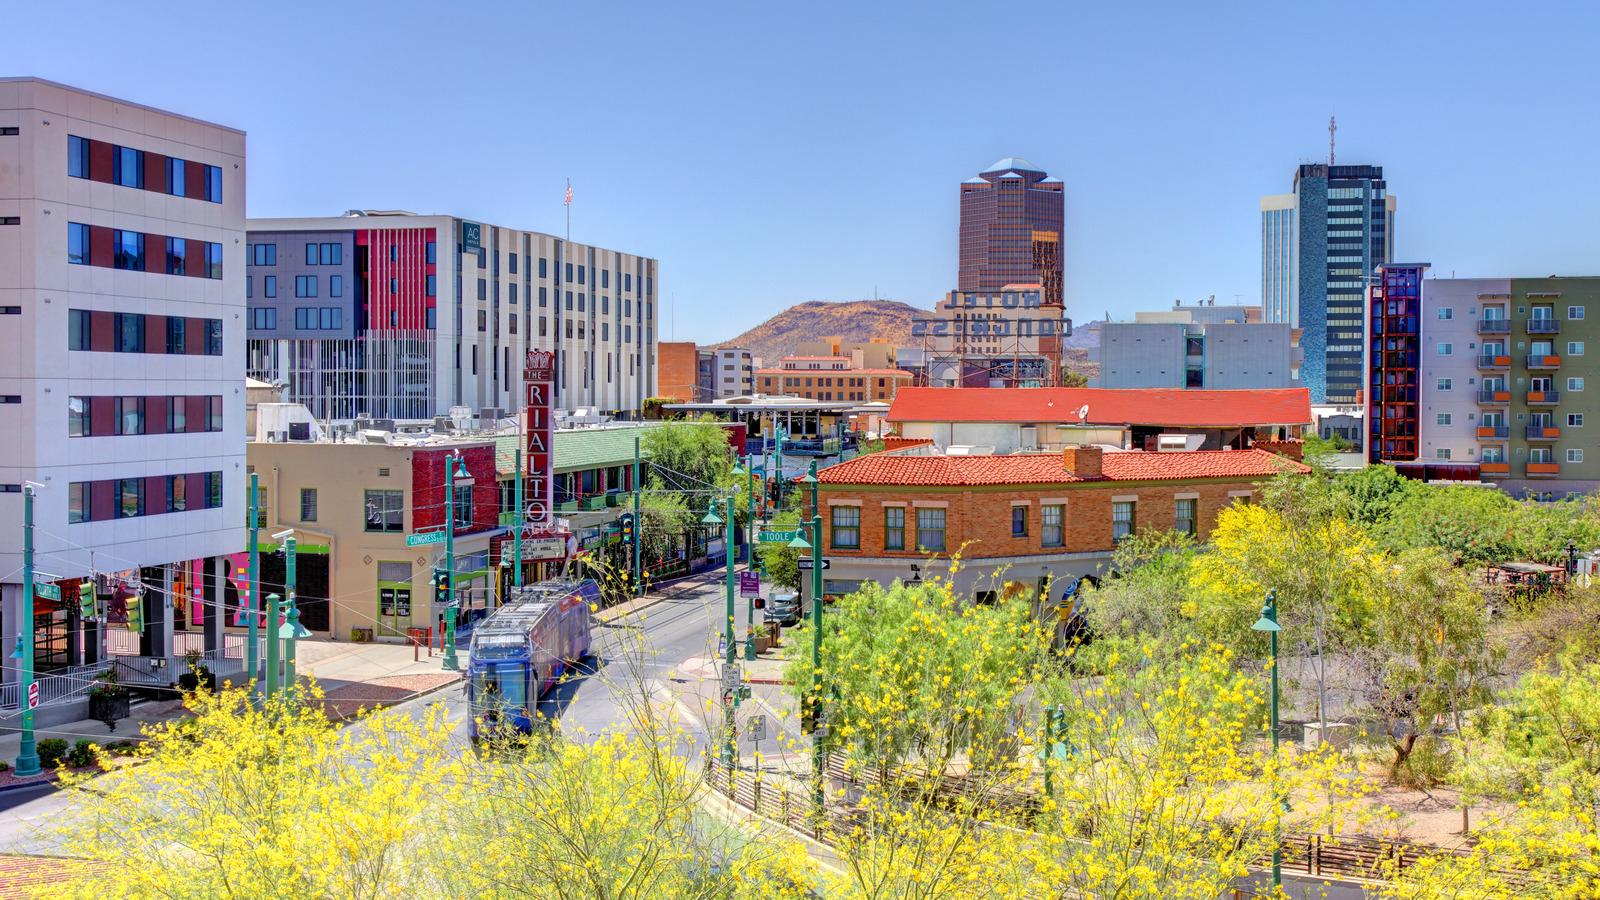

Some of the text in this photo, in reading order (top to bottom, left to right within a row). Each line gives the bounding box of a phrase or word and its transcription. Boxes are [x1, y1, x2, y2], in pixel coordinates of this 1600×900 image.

[467, 227, 479, 240] AC
[528, 371, 542, 379] THE
[527, 385, 546, 521] RIALTO
[507, 522, 557, 536] RALTO
[410, 533, 437, 545] CONGRESS
[765, 532, 790, 541] TOOLE
